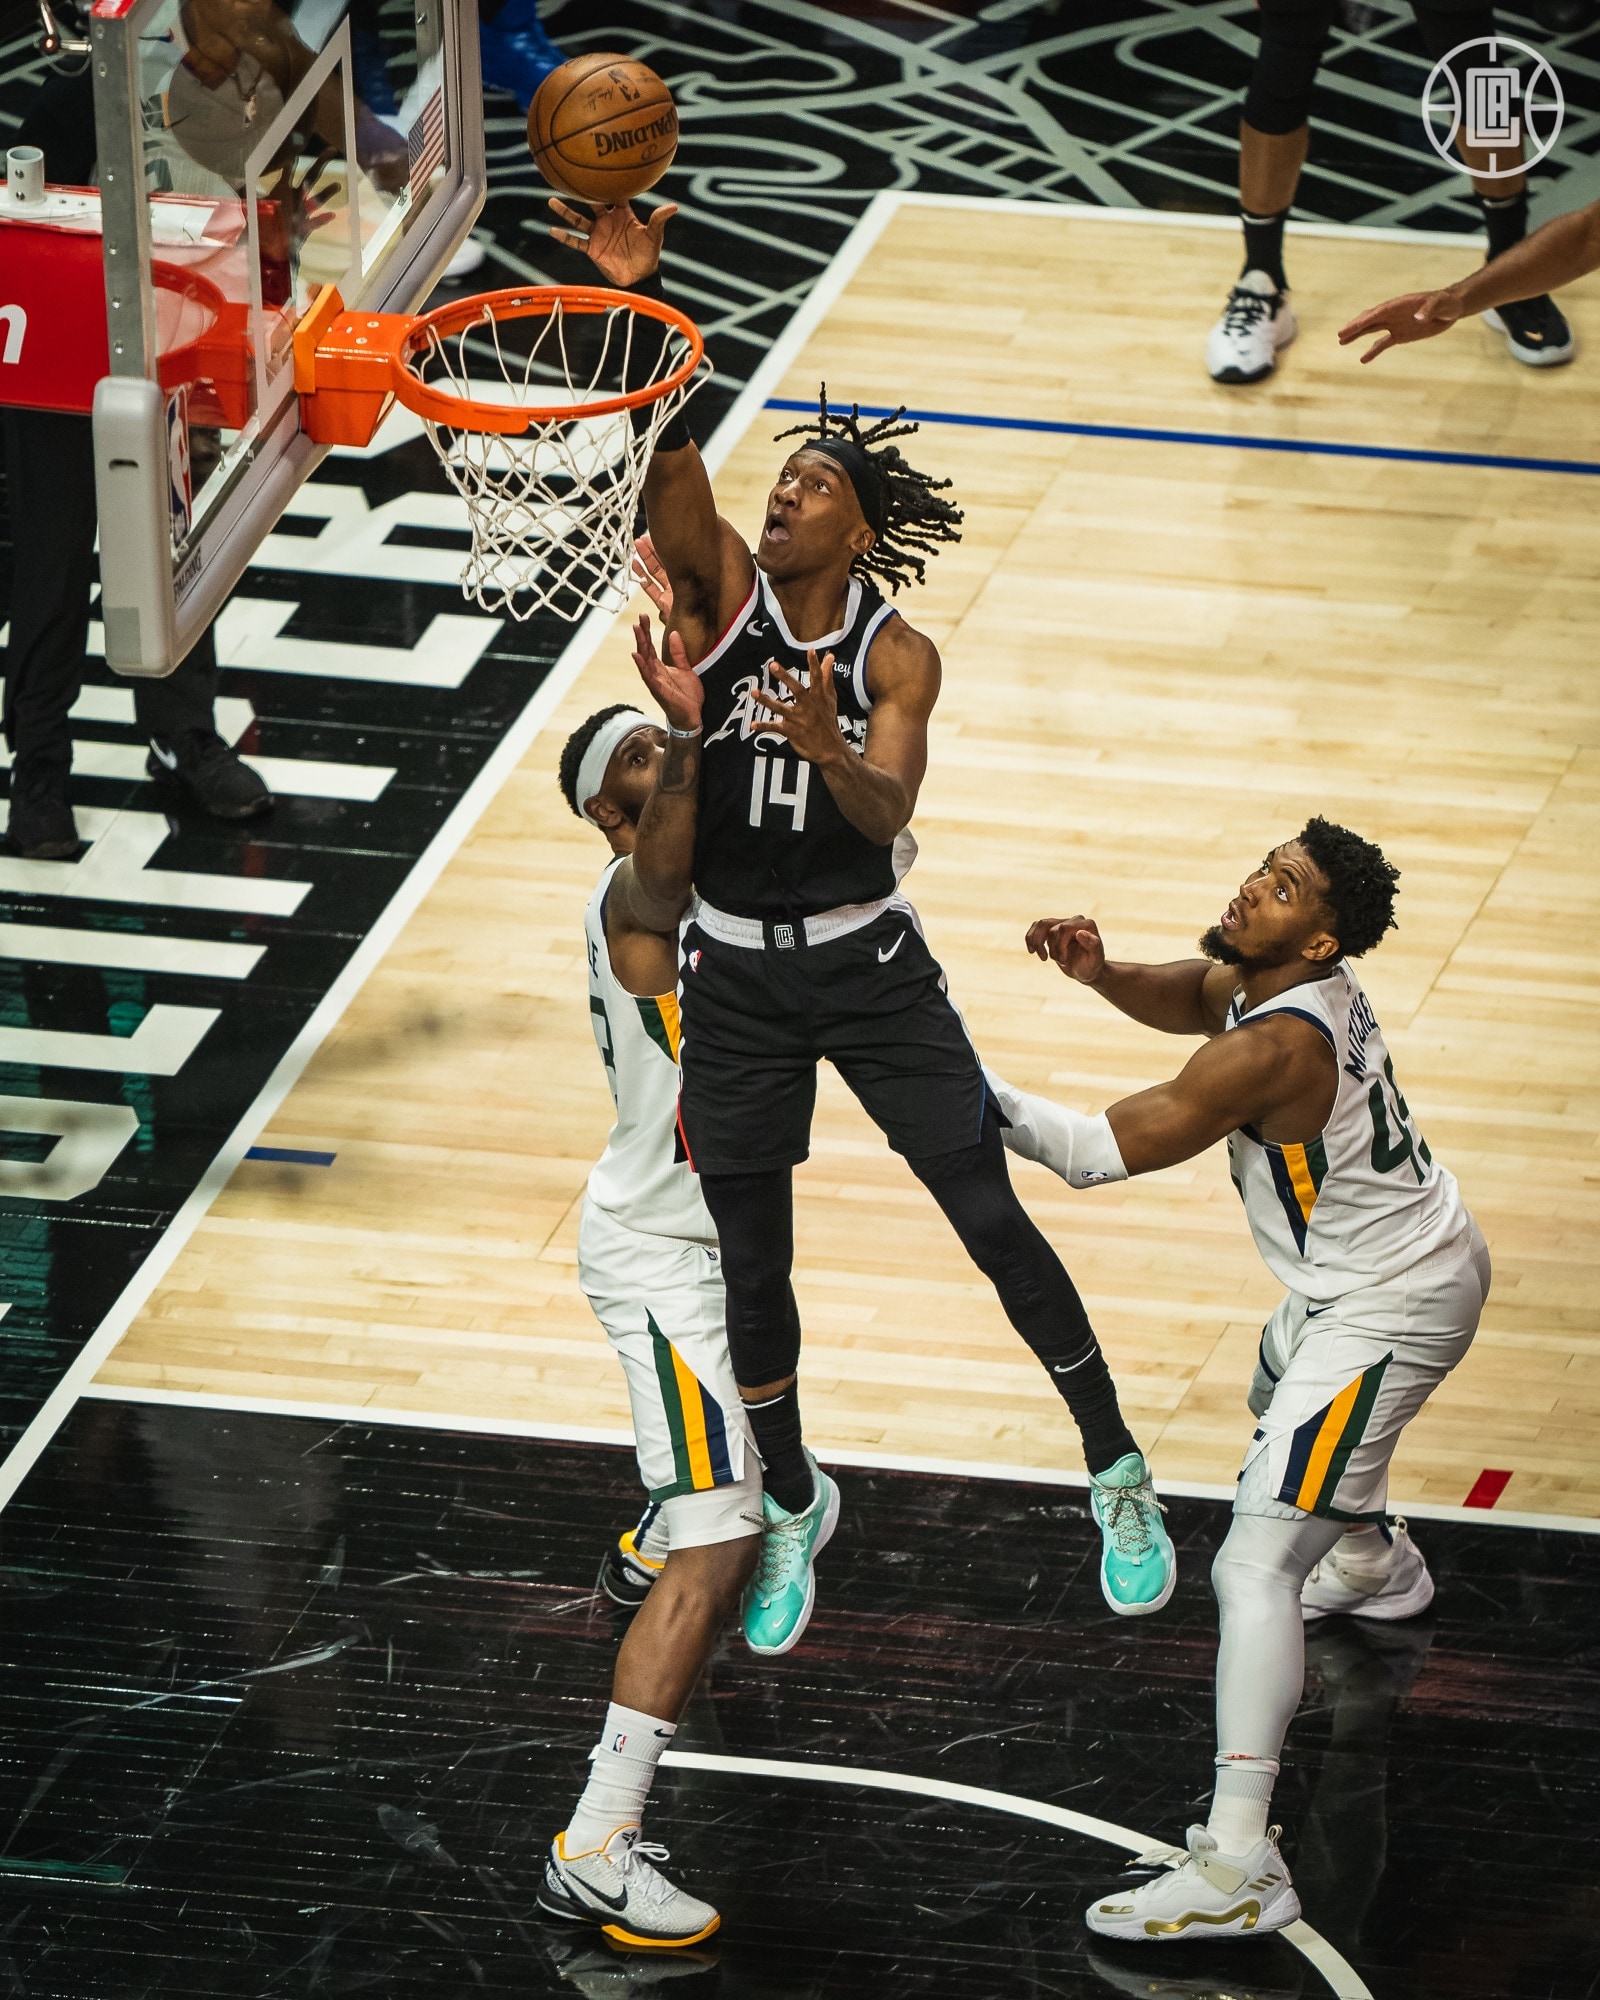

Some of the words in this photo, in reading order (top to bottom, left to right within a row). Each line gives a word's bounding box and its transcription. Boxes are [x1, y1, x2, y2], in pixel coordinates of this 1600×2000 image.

[832, 661, 852, 679] ney
[749, 756, 811, 832] 14
[1343, 991, 1382, 1084] MITCHE
